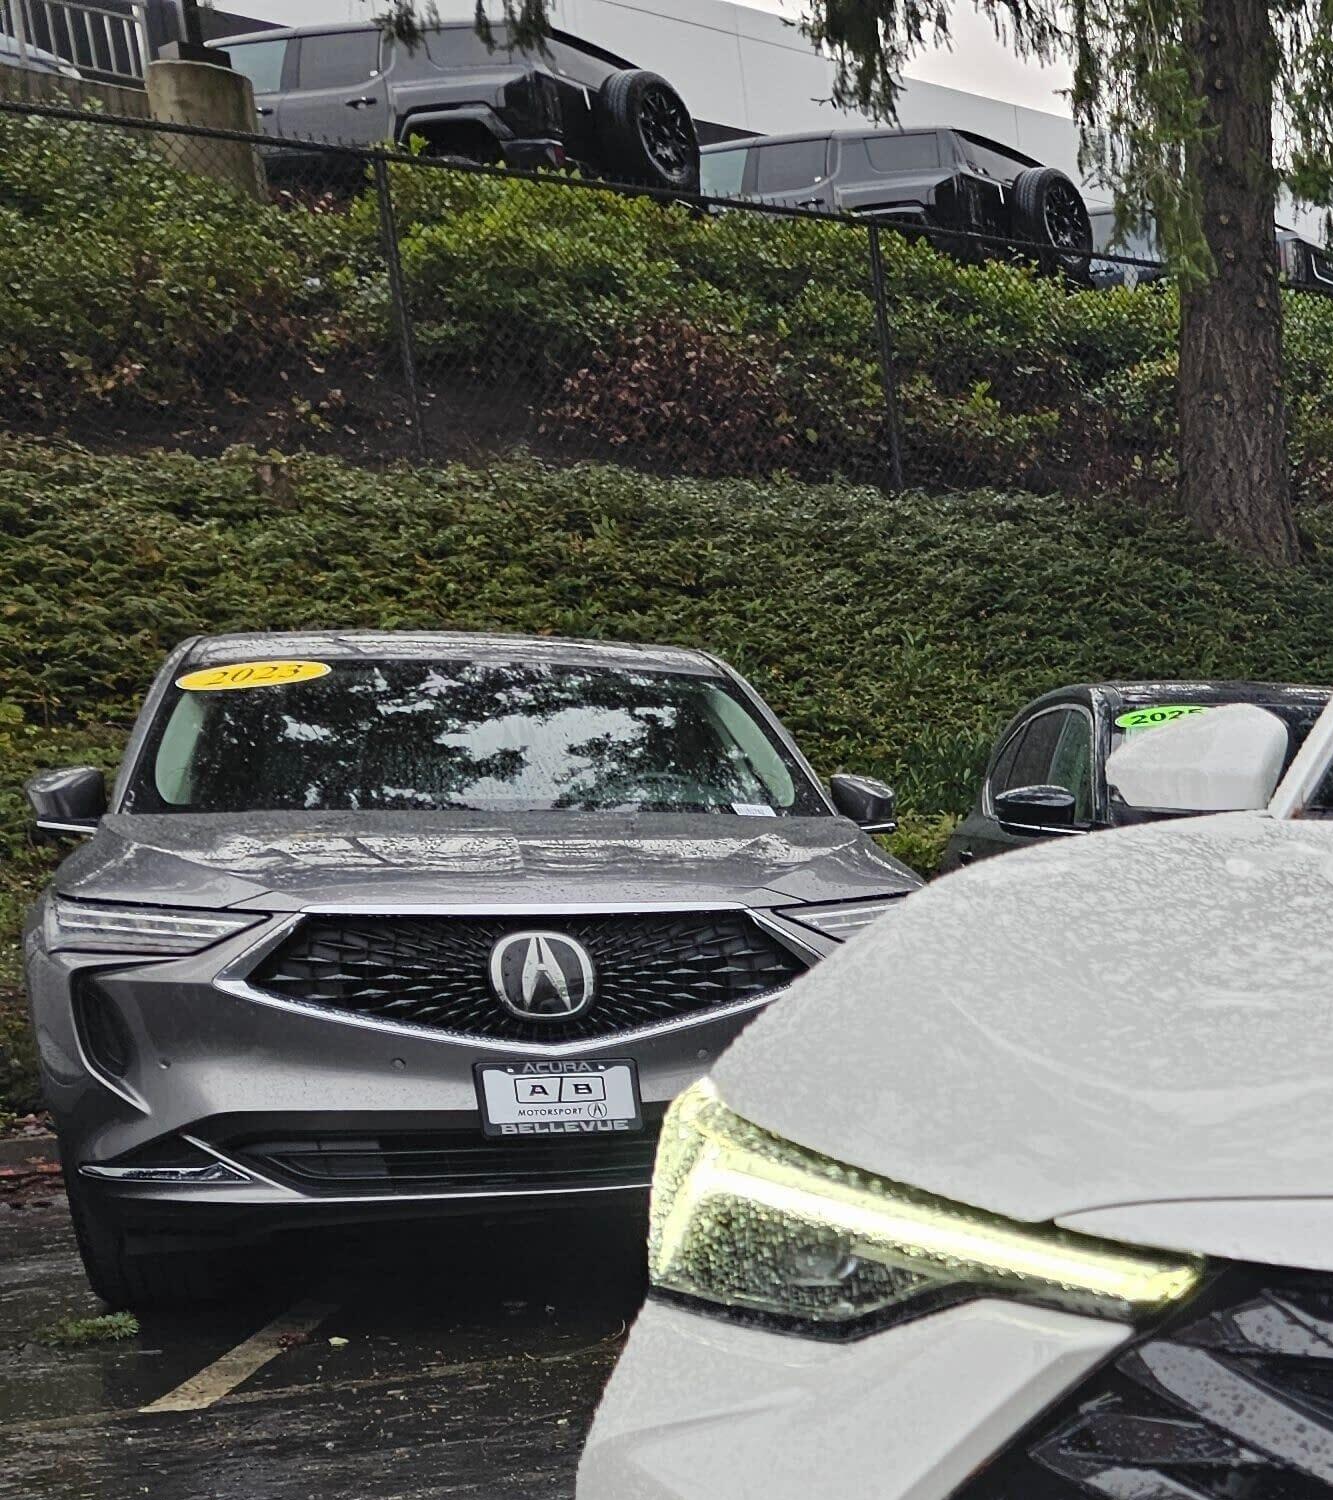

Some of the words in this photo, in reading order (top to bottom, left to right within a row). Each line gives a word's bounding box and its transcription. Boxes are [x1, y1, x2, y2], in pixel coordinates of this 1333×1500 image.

[521, 1061, 593, 1074] ACURA
[517, 1107, 583, 1117] MOTORSPORT
[501, 1119, 630, 1135] BELLEVUE
